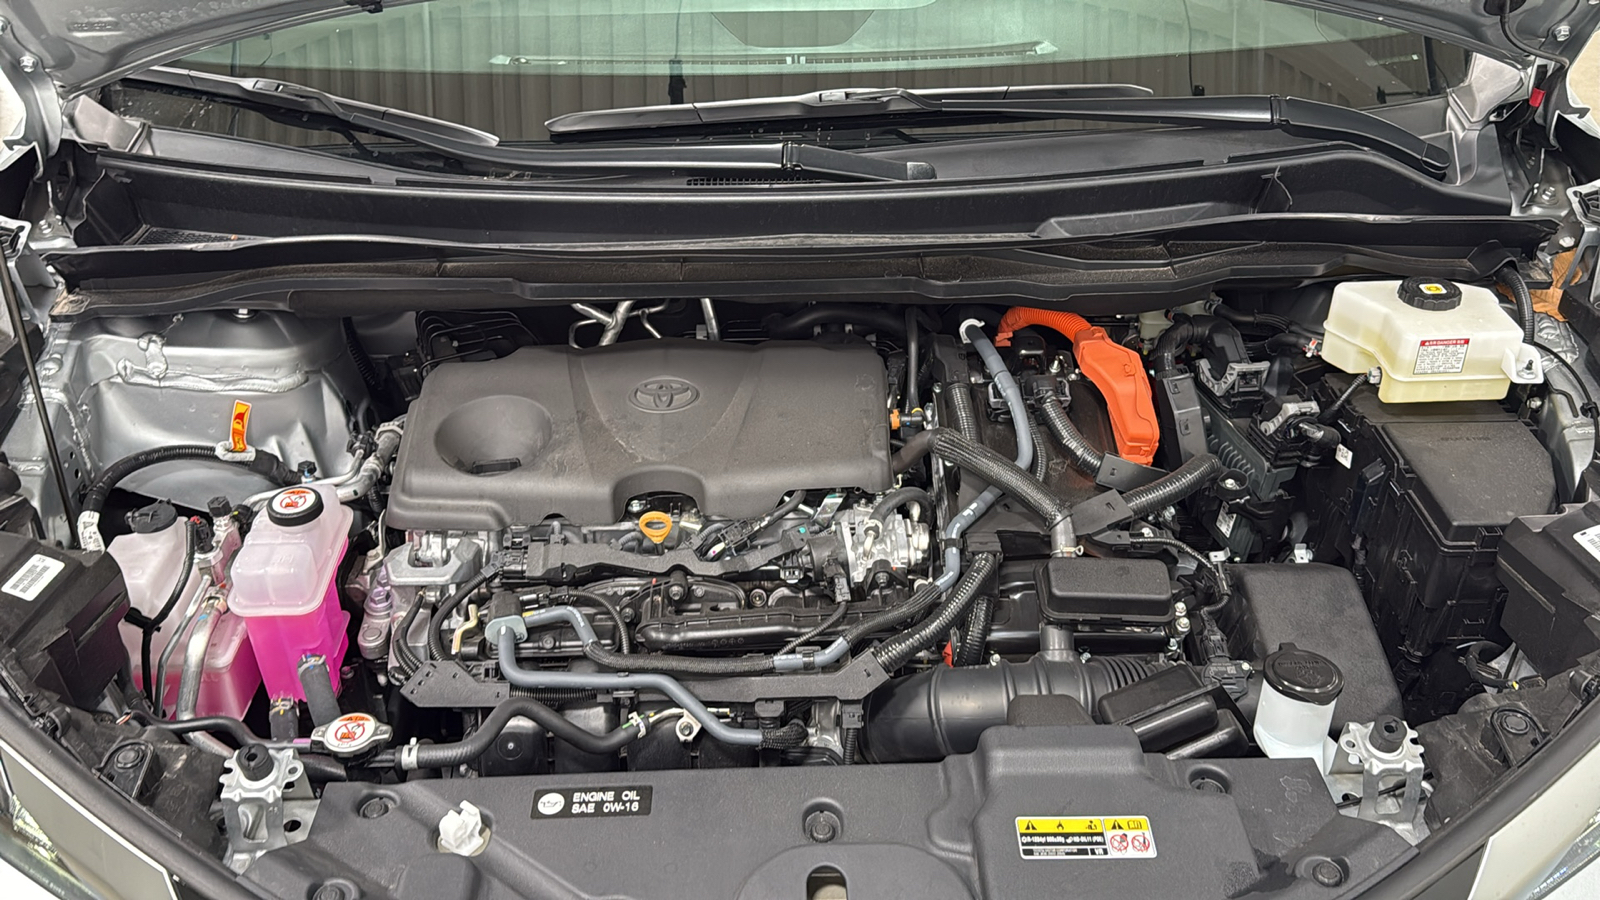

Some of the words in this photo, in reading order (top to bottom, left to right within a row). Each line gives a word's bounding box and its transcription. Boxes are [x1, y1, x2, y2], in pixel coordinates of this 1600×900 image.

[572, 791, 615, 802] ENGINE
[621, 790, 640, 801] OIL
[571, 803, 596, 814] SAE
[602, 801, 640, 813] 0W-16
